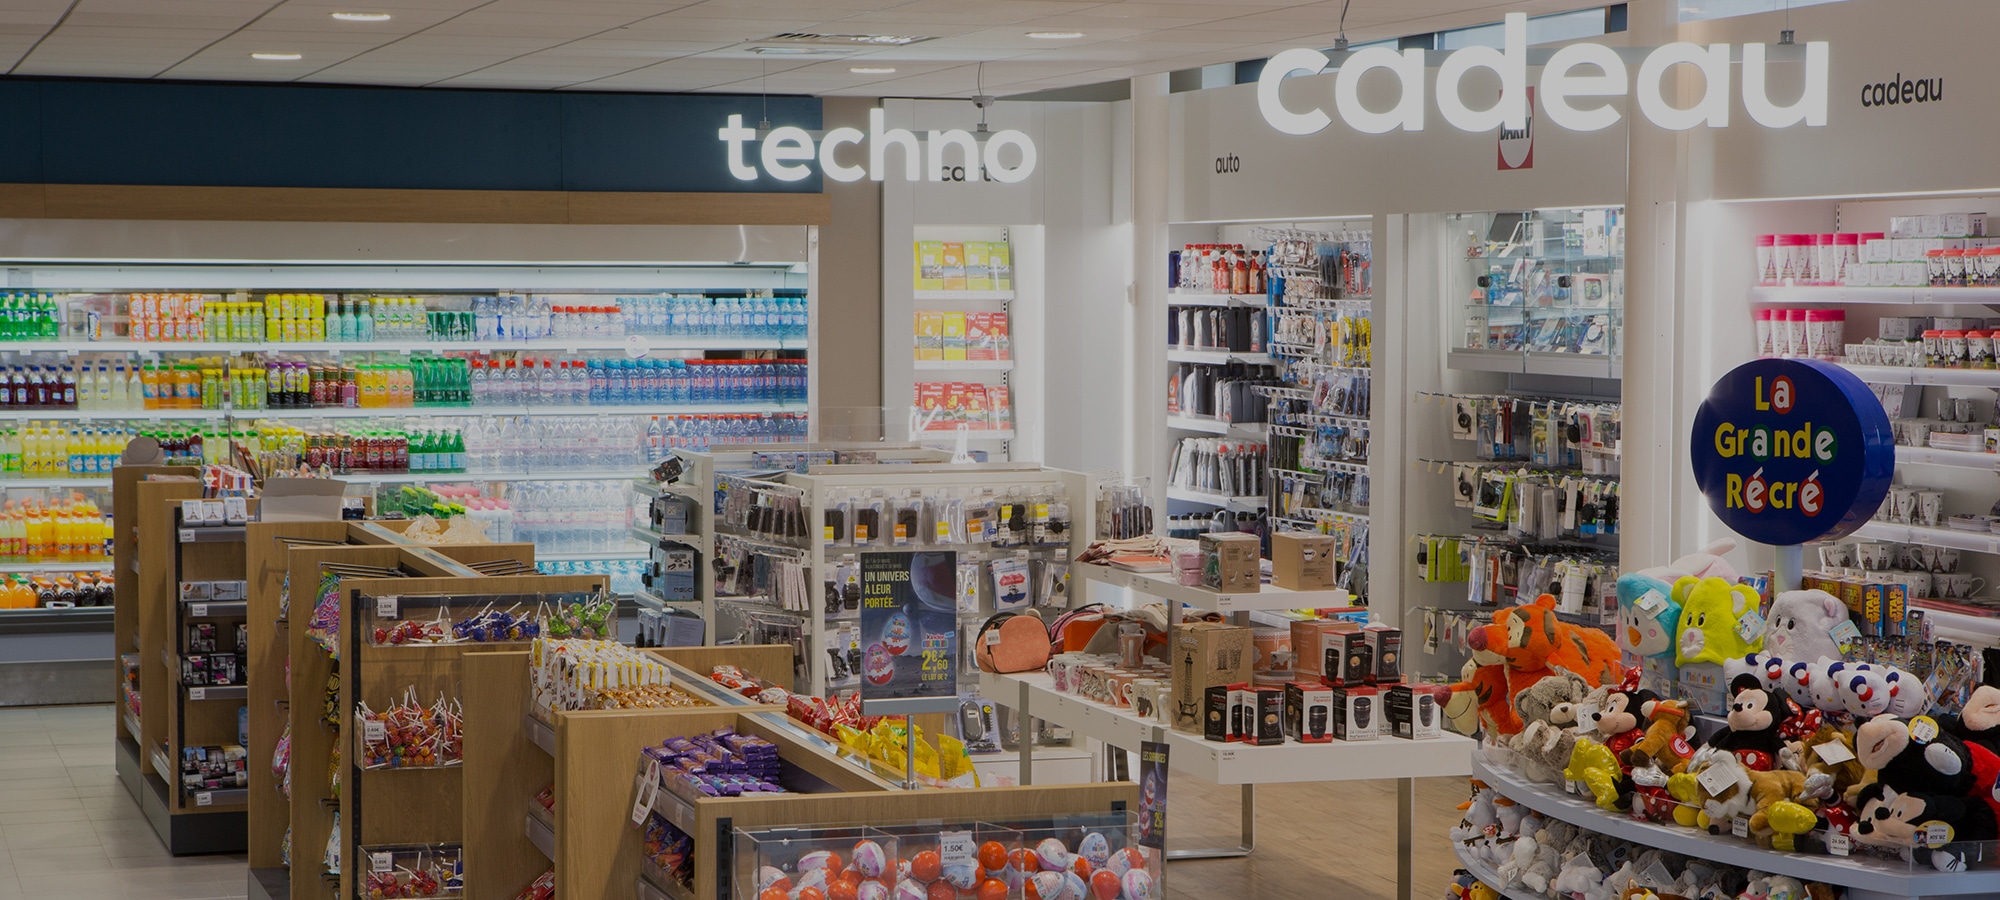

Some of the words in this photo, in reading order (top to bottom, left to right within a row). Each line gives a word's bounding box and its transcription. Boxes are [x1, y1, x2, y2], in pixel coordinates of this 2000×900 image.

[1258, 12, 1829, 135] cadeau
[1861, 72, 1943, 108] cadeau
[719, 107, 1037, 183] techno
[1214, 152, 1240, 175] auto
[1755, 375, 1790, 411] La
[1715, 421, 1835, 461] Grande
[1726, 466, 1820, 513] Récré
[864, 571, 875, 582] UN
[877, 571, 909, 582] UNIVERS
[864, 583, 870, 594] À
[872, 583, 891, 594] LEUR
[864, 597, 900, 608] PORTÉE...
[1866, 591, 1874, 620] STAR
[1872, 588, 1881, 623] WARS
[1889, 591, 1897, 620] STAR
[1896, 588, 1905, 622] WARS
